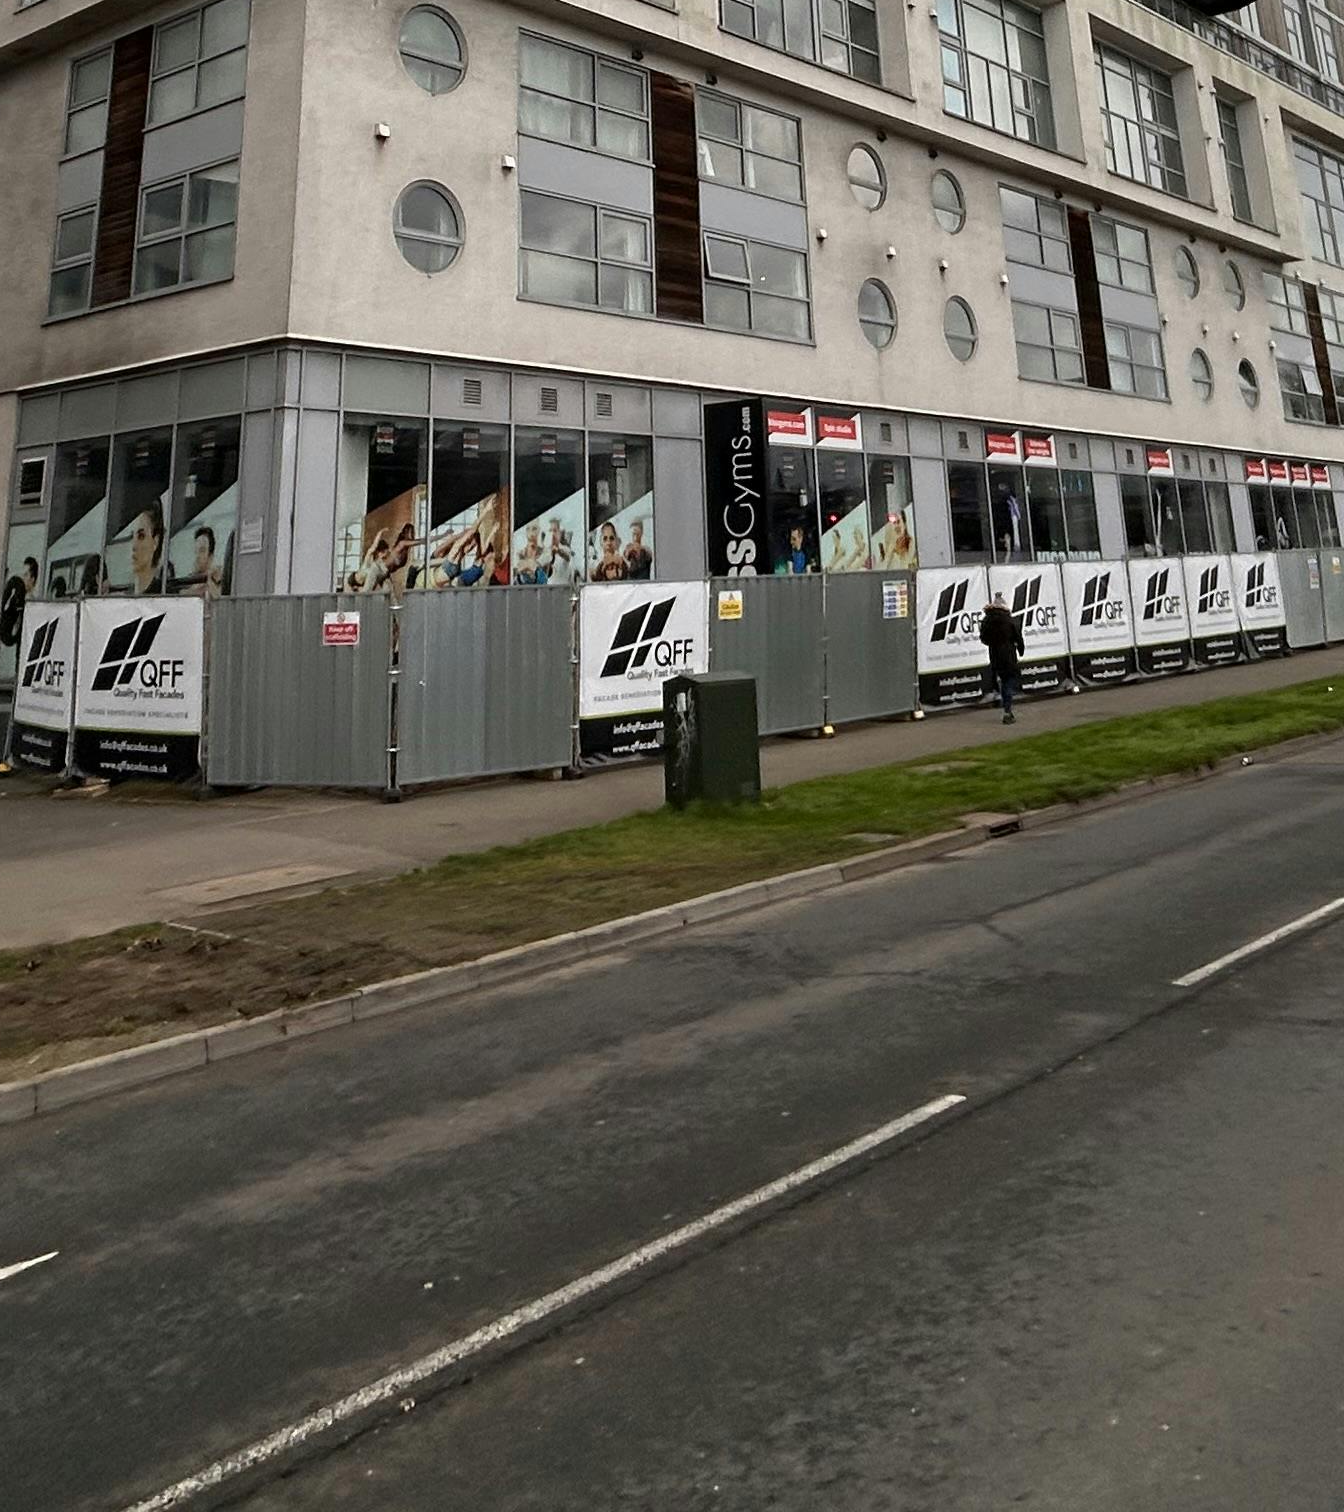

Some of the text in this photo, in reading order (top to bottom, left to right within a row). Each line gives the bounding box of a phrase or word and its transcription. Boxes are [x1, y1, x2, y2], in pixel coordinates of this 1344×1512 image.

[1035, 606, 1057, 627] QFF
[1104, 600, 1123, 620] QFF
[654, 638, 694, 667] QFF
[139, 659, 184, 688] QFF
[626, 668, 653, 682] Quality
[654, 668, 668, 678] Fast
[113, 688, 185, 701] Quality Fast Facades
